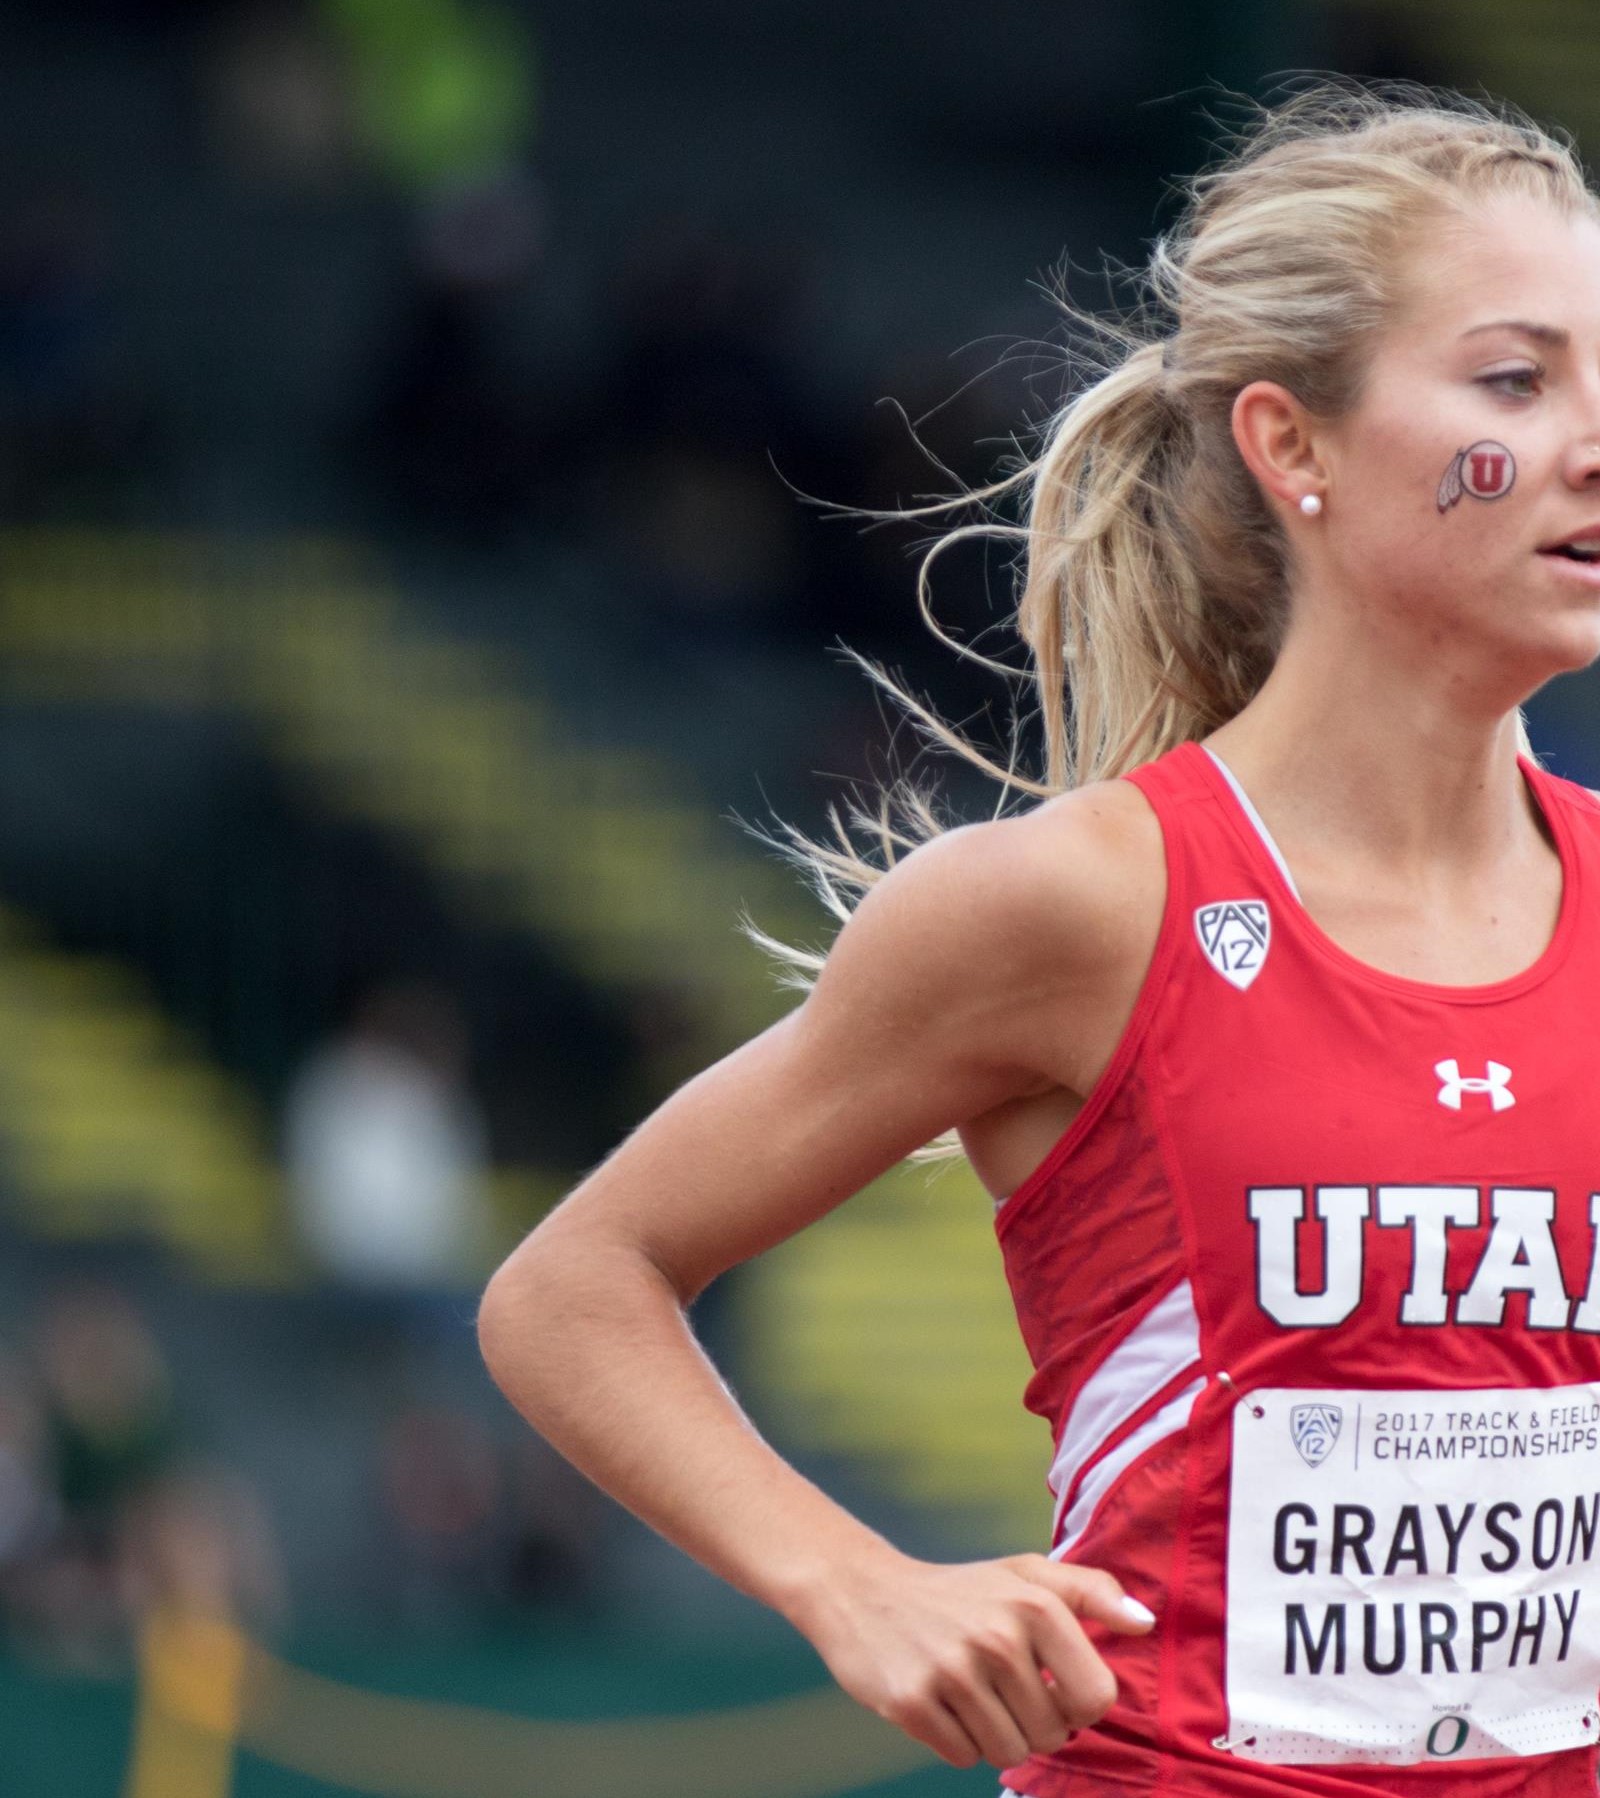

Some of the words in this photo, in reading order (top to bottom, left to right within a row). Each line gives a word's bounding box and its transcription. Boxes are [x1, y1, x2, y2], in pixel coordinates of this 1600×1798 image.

[1470, 453, 1506, 493] U
[1199, 904, 1266, 956] PAC
[1220, 939, 1257, 971] 12
[1375, 1413, 1434, 1432] 2017
[1446, 1411, 1519, 1431] TRACK
[1530, 1411, 1540, 1429] &
[1550, 1404, 1600, 1427] FIELD
[1306, 1437, 1325, 1455] 12
[1373, 1428, 1598, 1460] CHAMPIONSHIPS
[1284, 1590, 1581, 1676] MURPHY
